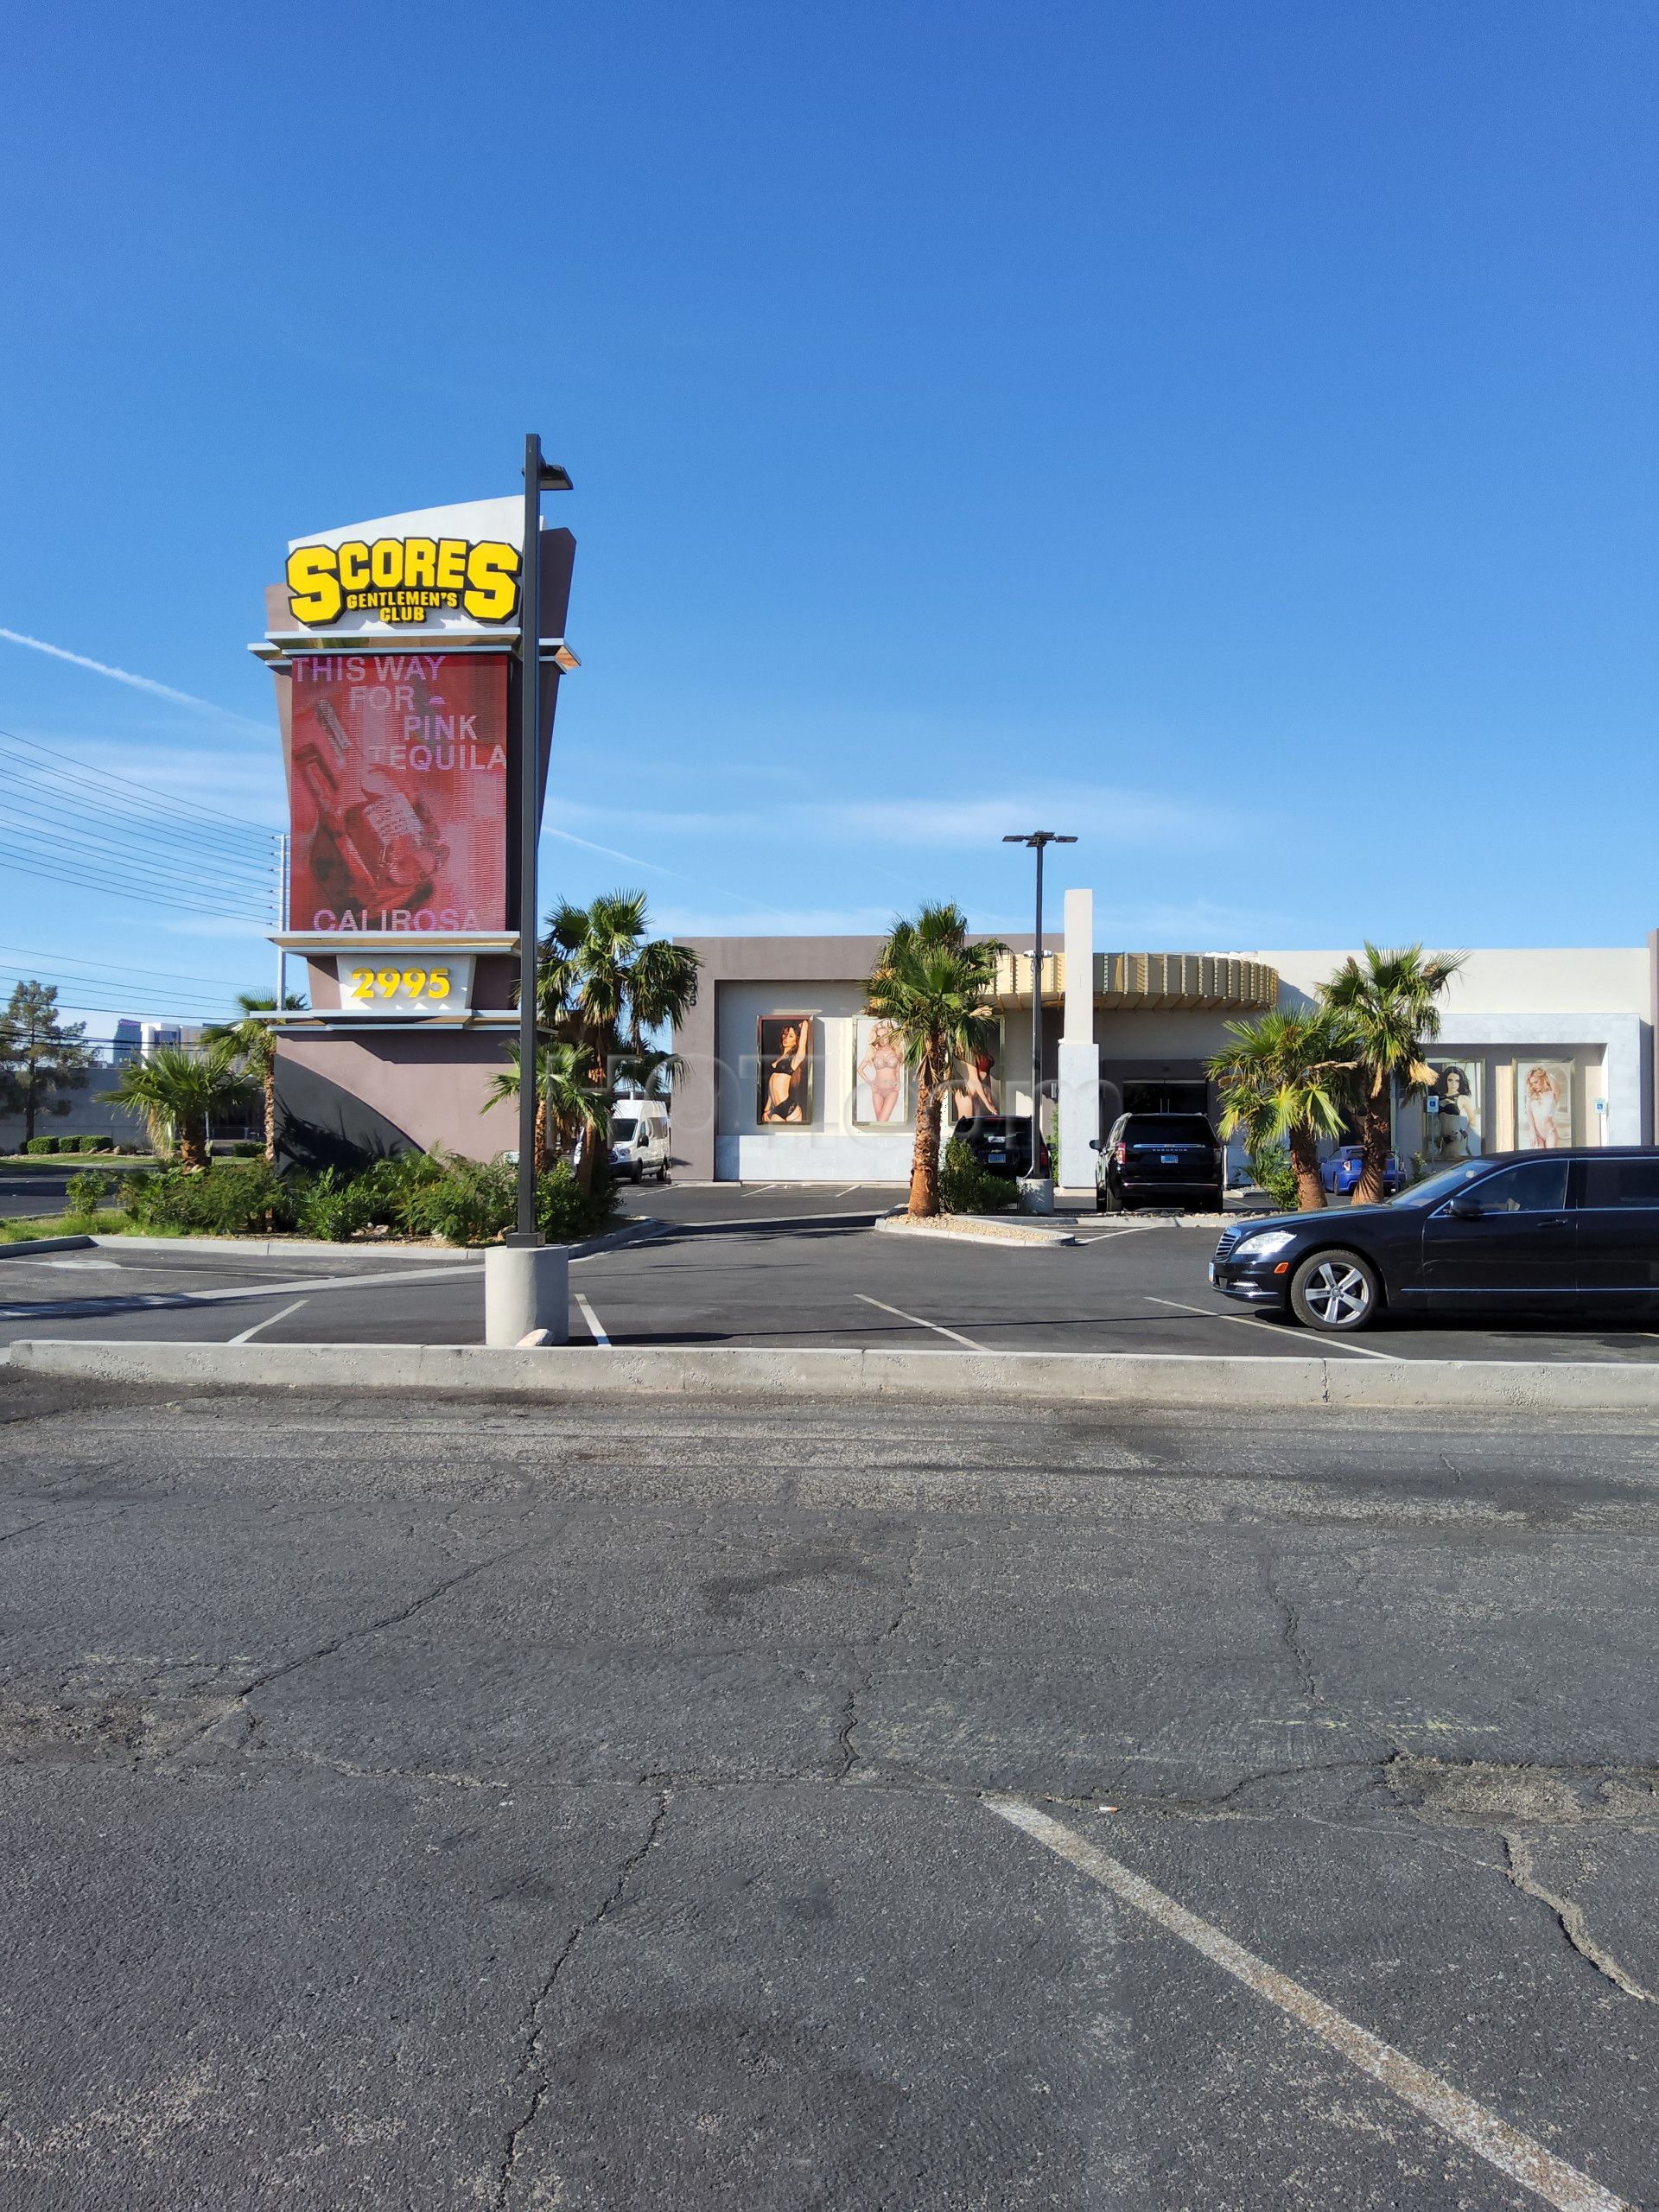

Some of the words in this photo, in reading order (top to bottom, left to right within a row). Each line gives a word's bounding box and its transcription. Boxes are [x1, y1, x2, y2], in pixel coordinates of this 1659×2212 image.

[287, 537, 522, 623] SCORES
[346, 590, 458, 609] GENTLEMEN'S
[379, 606, 425, 622] CLUB
[292, 656, 365, 683] THIS
[373, 656, 446, 682] WAY
[350, 685, 415, 711] FOR
[404, 715, 477, 741] PINK
[369, 745, 507, 771] TEQUILA
[313, 908, 481, 931] CALIROSA
[351, 967, 450, 999] 2995
